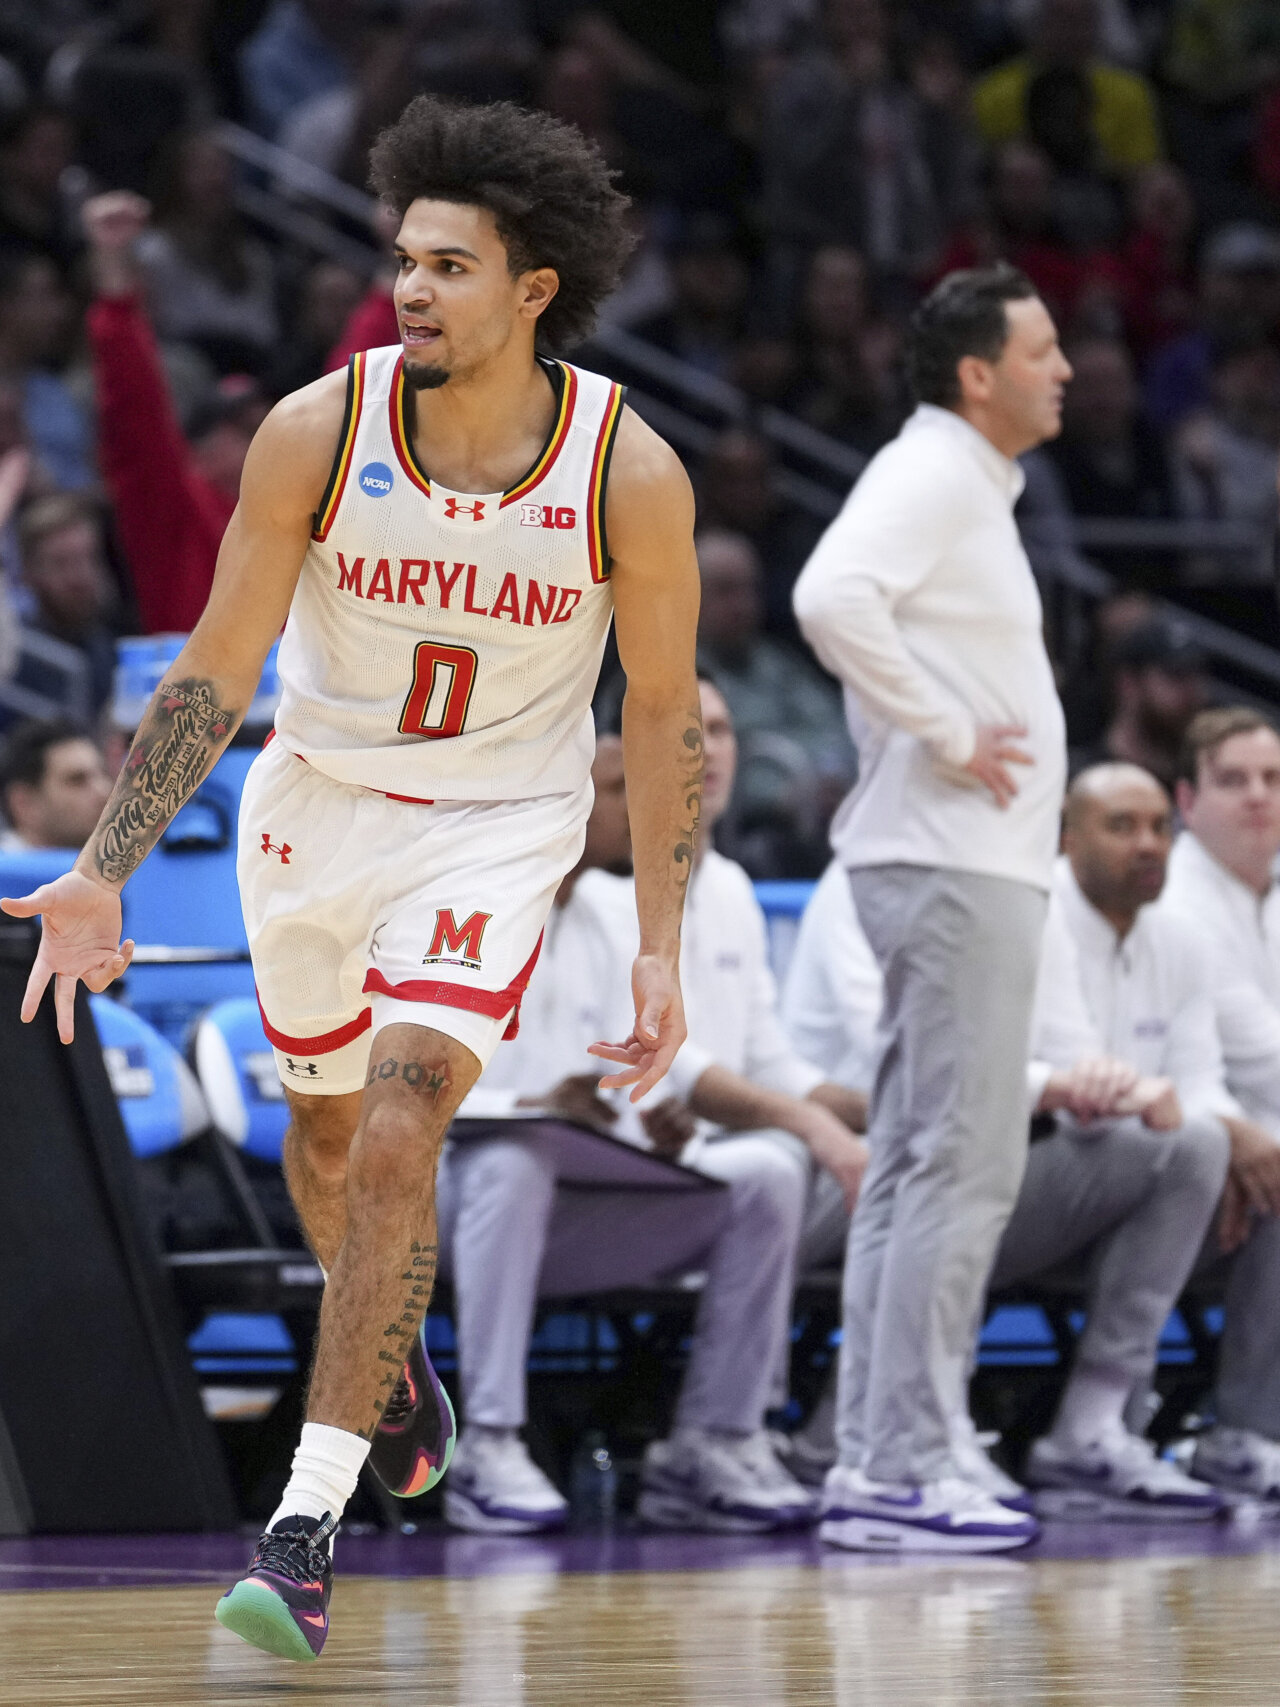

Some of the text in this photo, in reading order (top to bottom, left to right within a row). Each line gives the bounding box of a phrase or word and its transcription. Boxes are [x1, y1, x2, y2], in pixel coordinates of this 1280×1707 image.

[362, 476, 391, 491] NCAA
[336, 551, 582, 627] MARYLAND
[398, 640, 478, 739] 0
[146, 804, 162, 823] For
[156, 777, 176, 803] them
[171, 759, 185, 776] I'd
[182, 741, 196, 760] risk
[197, 716, 209, 733] all
[104, 800, 147, 859] My
[424, 908, 493, 962] M
